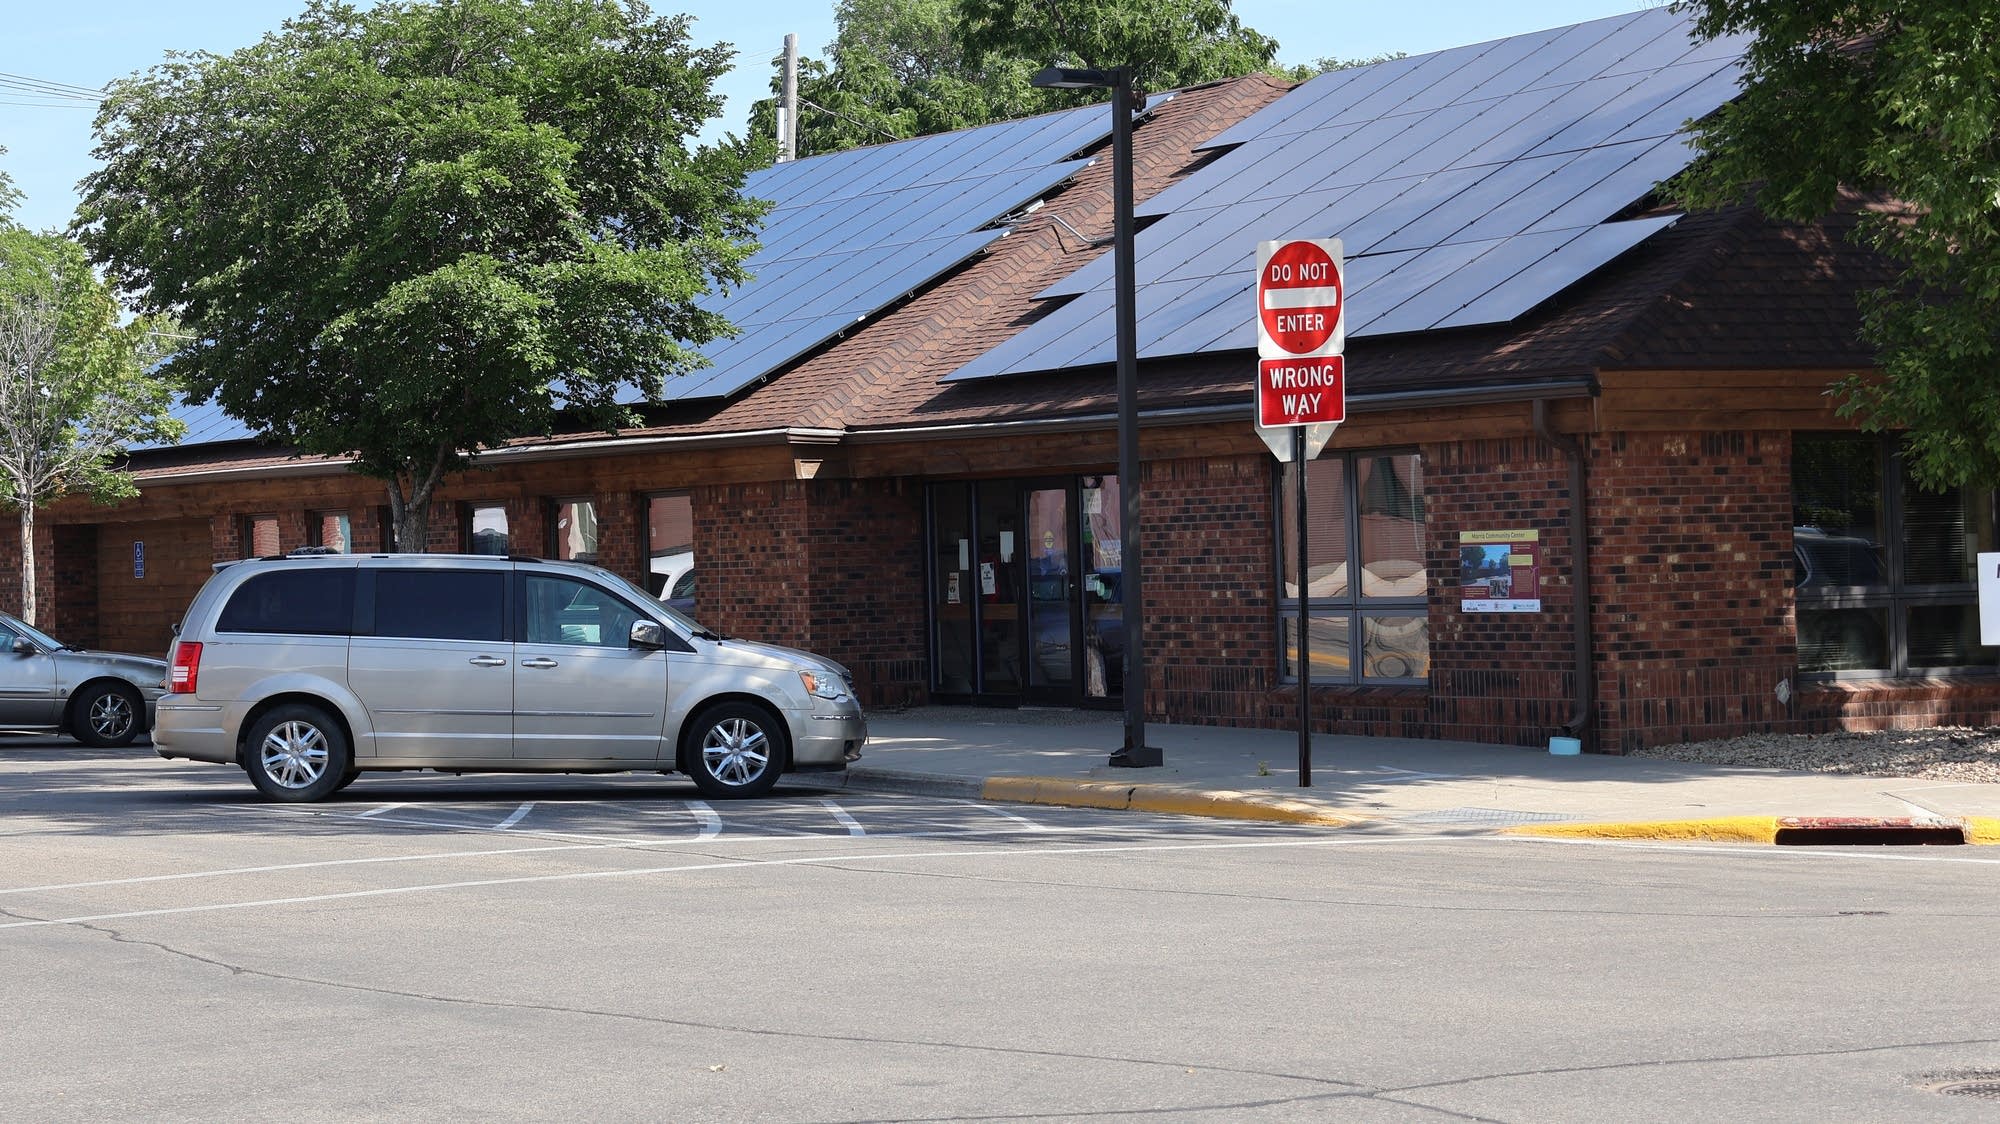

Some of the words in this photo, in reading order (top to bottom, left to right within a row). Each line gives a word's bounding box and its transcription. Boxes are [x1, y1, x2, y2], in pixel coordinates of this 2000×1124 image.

[1271, 265, 1291, 282] DO
[1299, 263, 1328, 281] NOT
[1277, 314, 1324, 333] ENTER
[1269, 364, 1334, 389] WRONG
[1282, 393, 1322, 416] WAY
